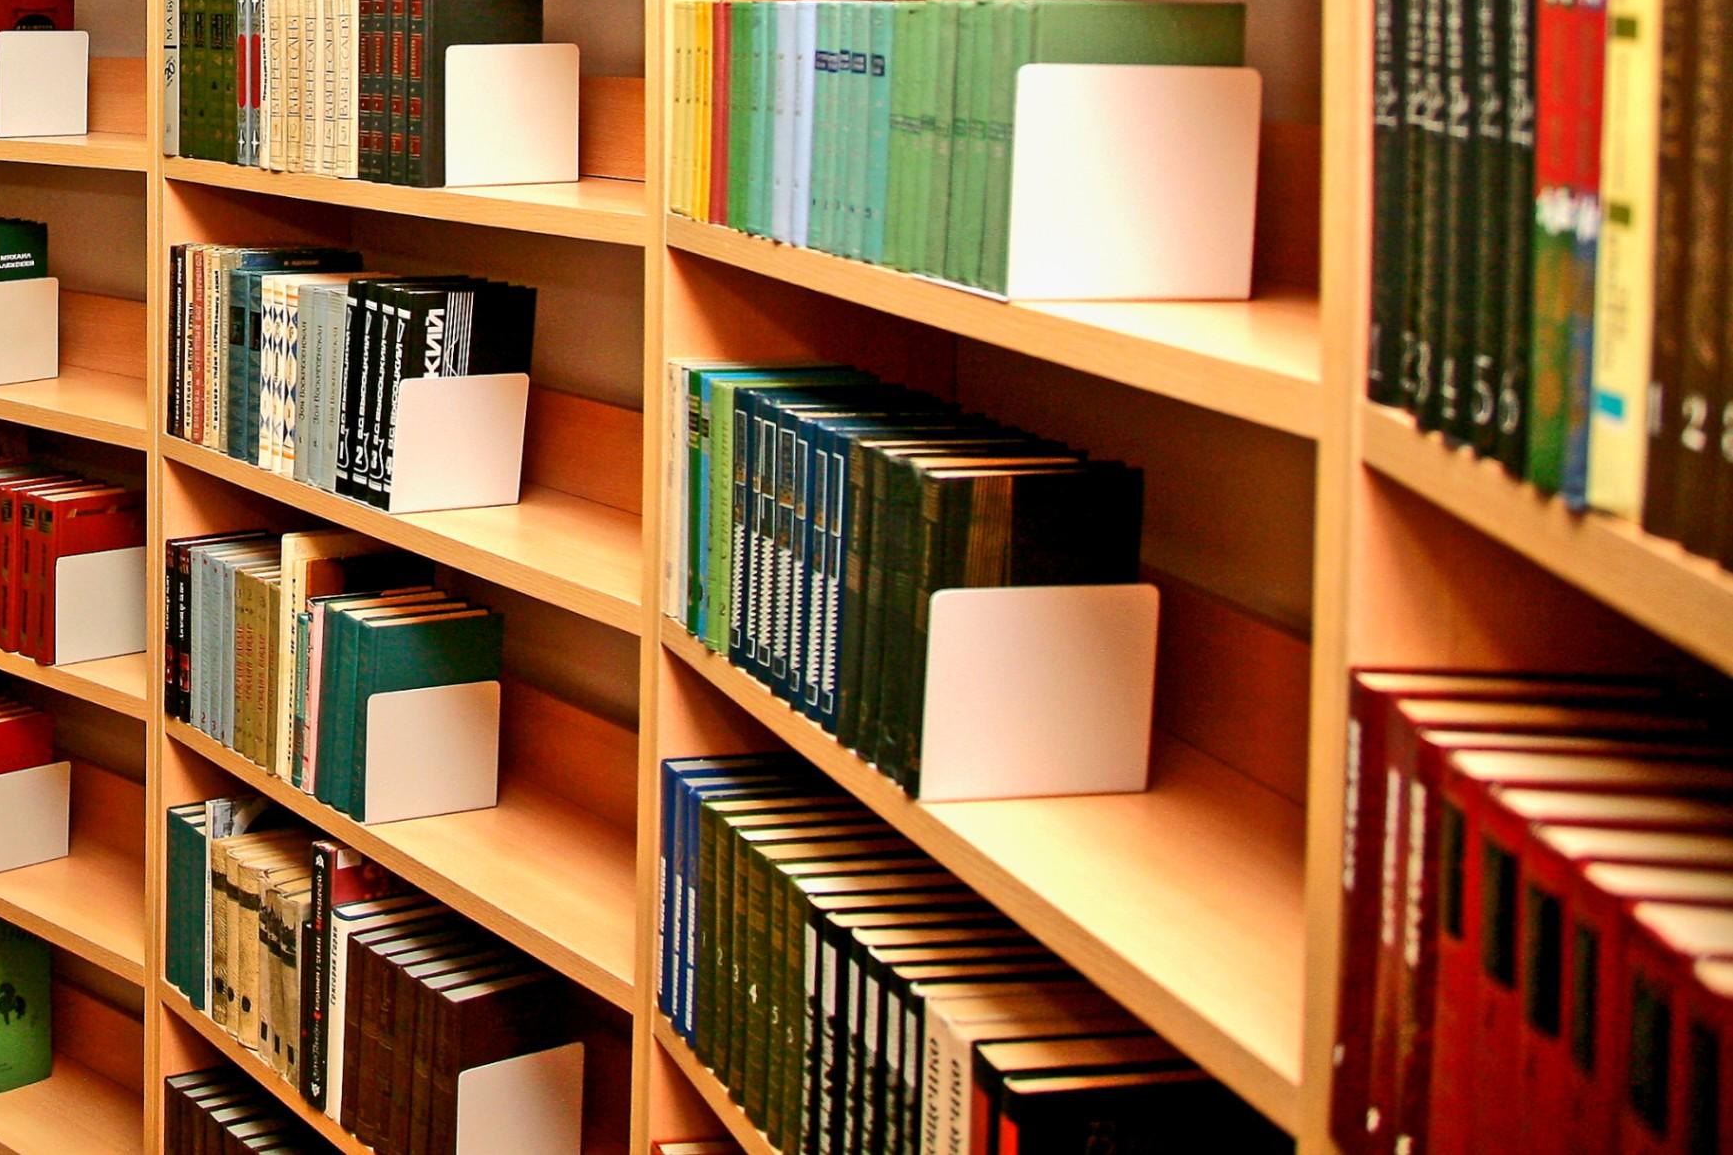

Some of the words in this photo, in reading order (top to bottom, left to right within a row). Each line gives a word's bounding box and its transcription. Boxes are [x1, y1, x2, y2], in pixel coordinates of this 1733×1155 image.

[423, 308, 445, 378] КИЙ
[1472, 353, 1495, 427] 5
[1499, 363, 1520, 435] 6
[339, 440, 345, 460] 1
[1680, 392, 1707, 453] 2
[354, 445, 364, 465] 2
[370, 450, 378, 469] 3
